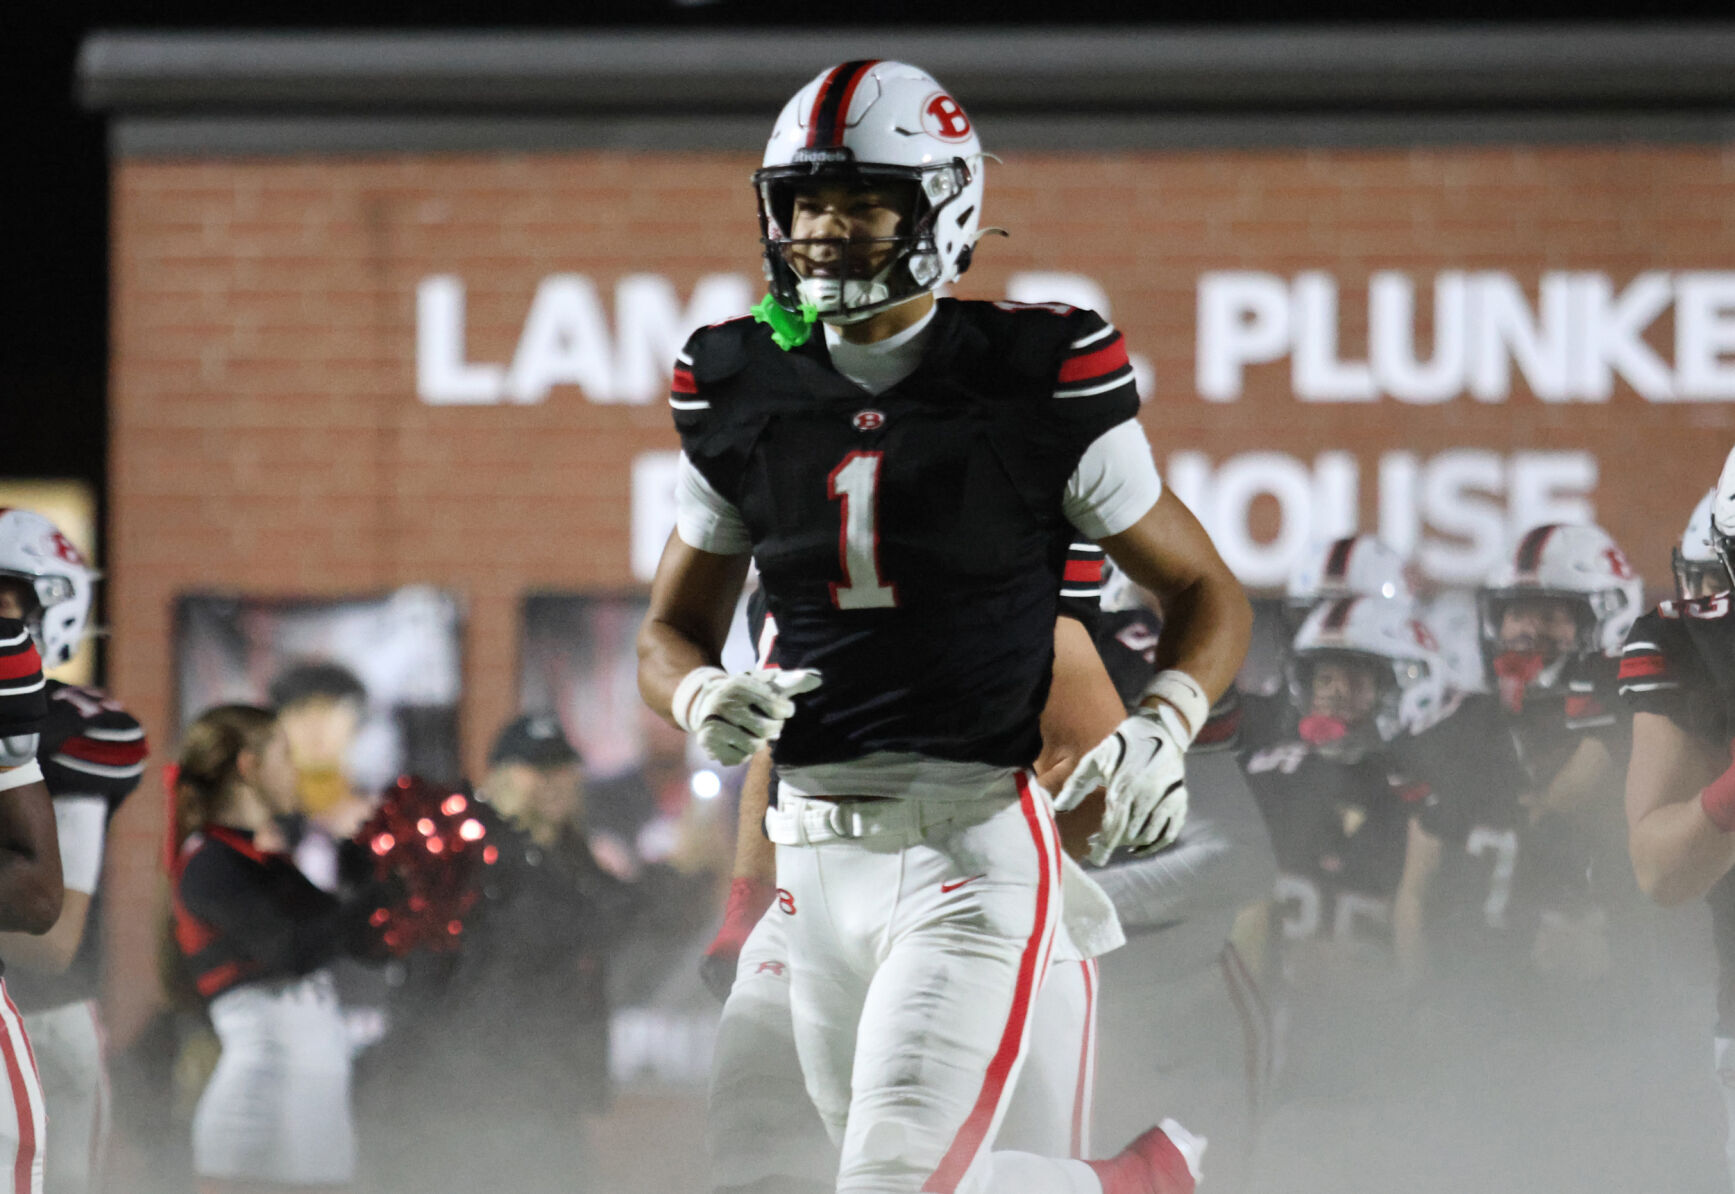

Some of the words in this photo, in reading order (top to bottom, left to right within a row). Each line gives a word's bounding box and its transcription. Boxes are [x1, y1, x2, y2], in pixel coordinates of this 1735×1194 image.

[926, 95, 971, 139] B
[414, 271, 757, 405] LAM
[1196, 268, 1735, 405] PLUNKE
[827, 450, 899, 610] 1
